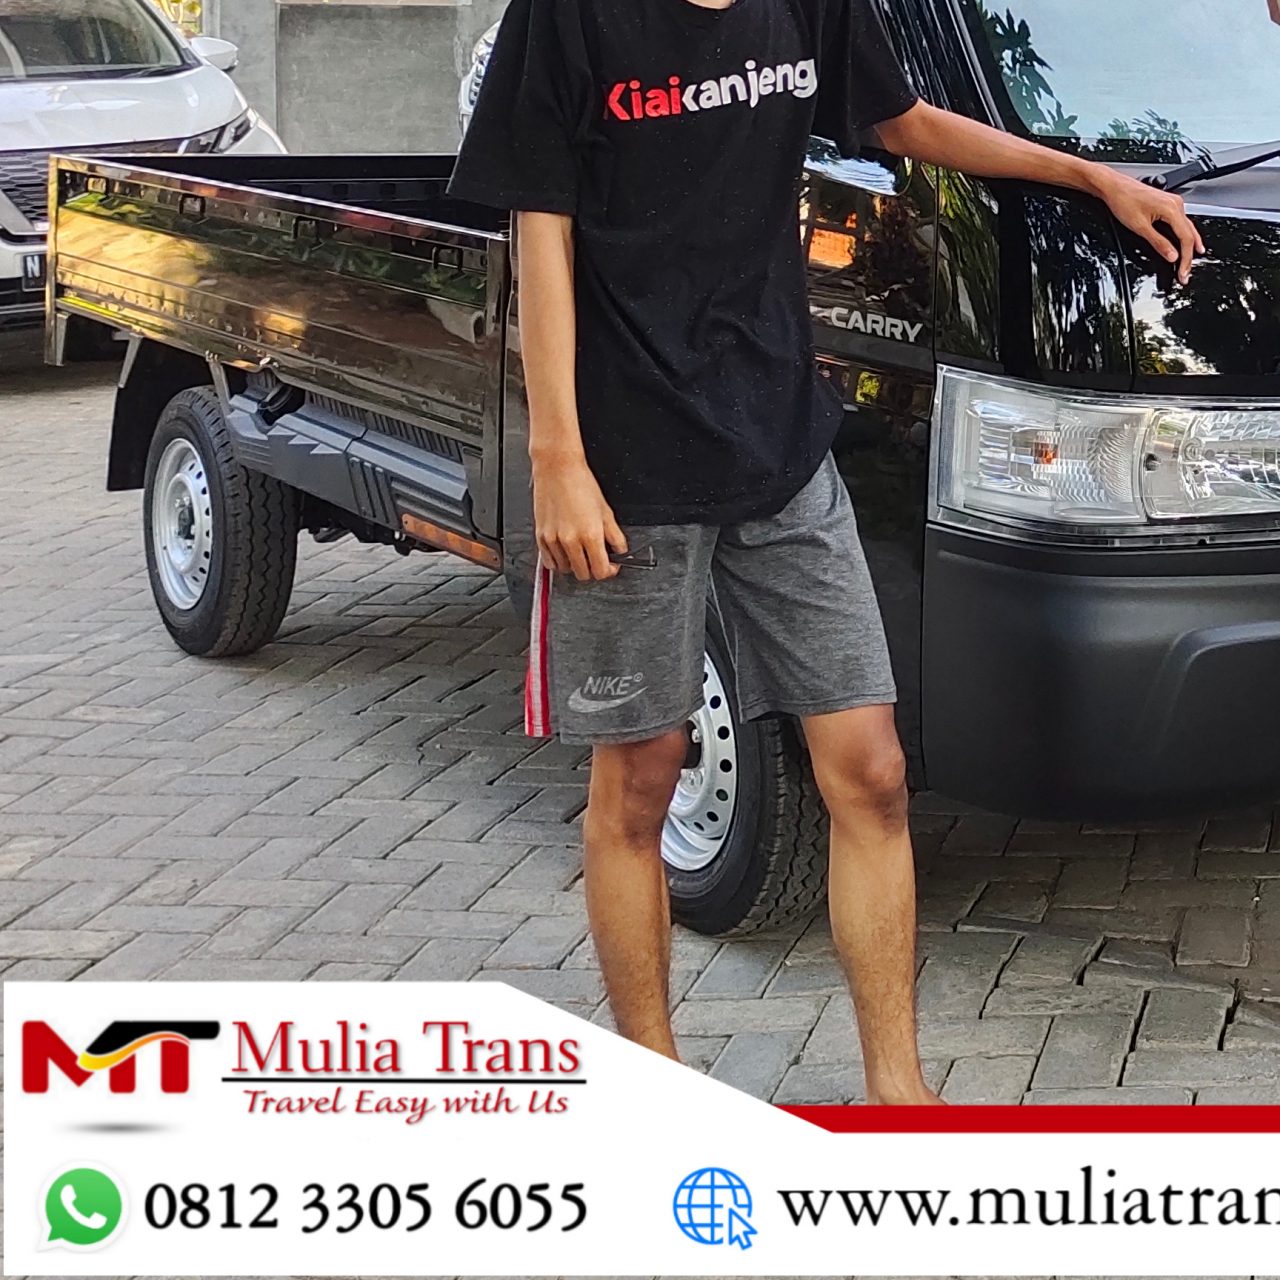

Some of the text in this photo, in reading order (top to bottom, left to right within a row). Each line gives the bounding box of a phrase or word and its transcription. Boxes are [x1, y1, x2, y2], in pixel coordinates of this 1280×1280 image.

[607, 58, 818, 121] Kiaikanjeng
[831, 306, 924, 343] CARRY
[583, 675, 634, 696] NIKE
